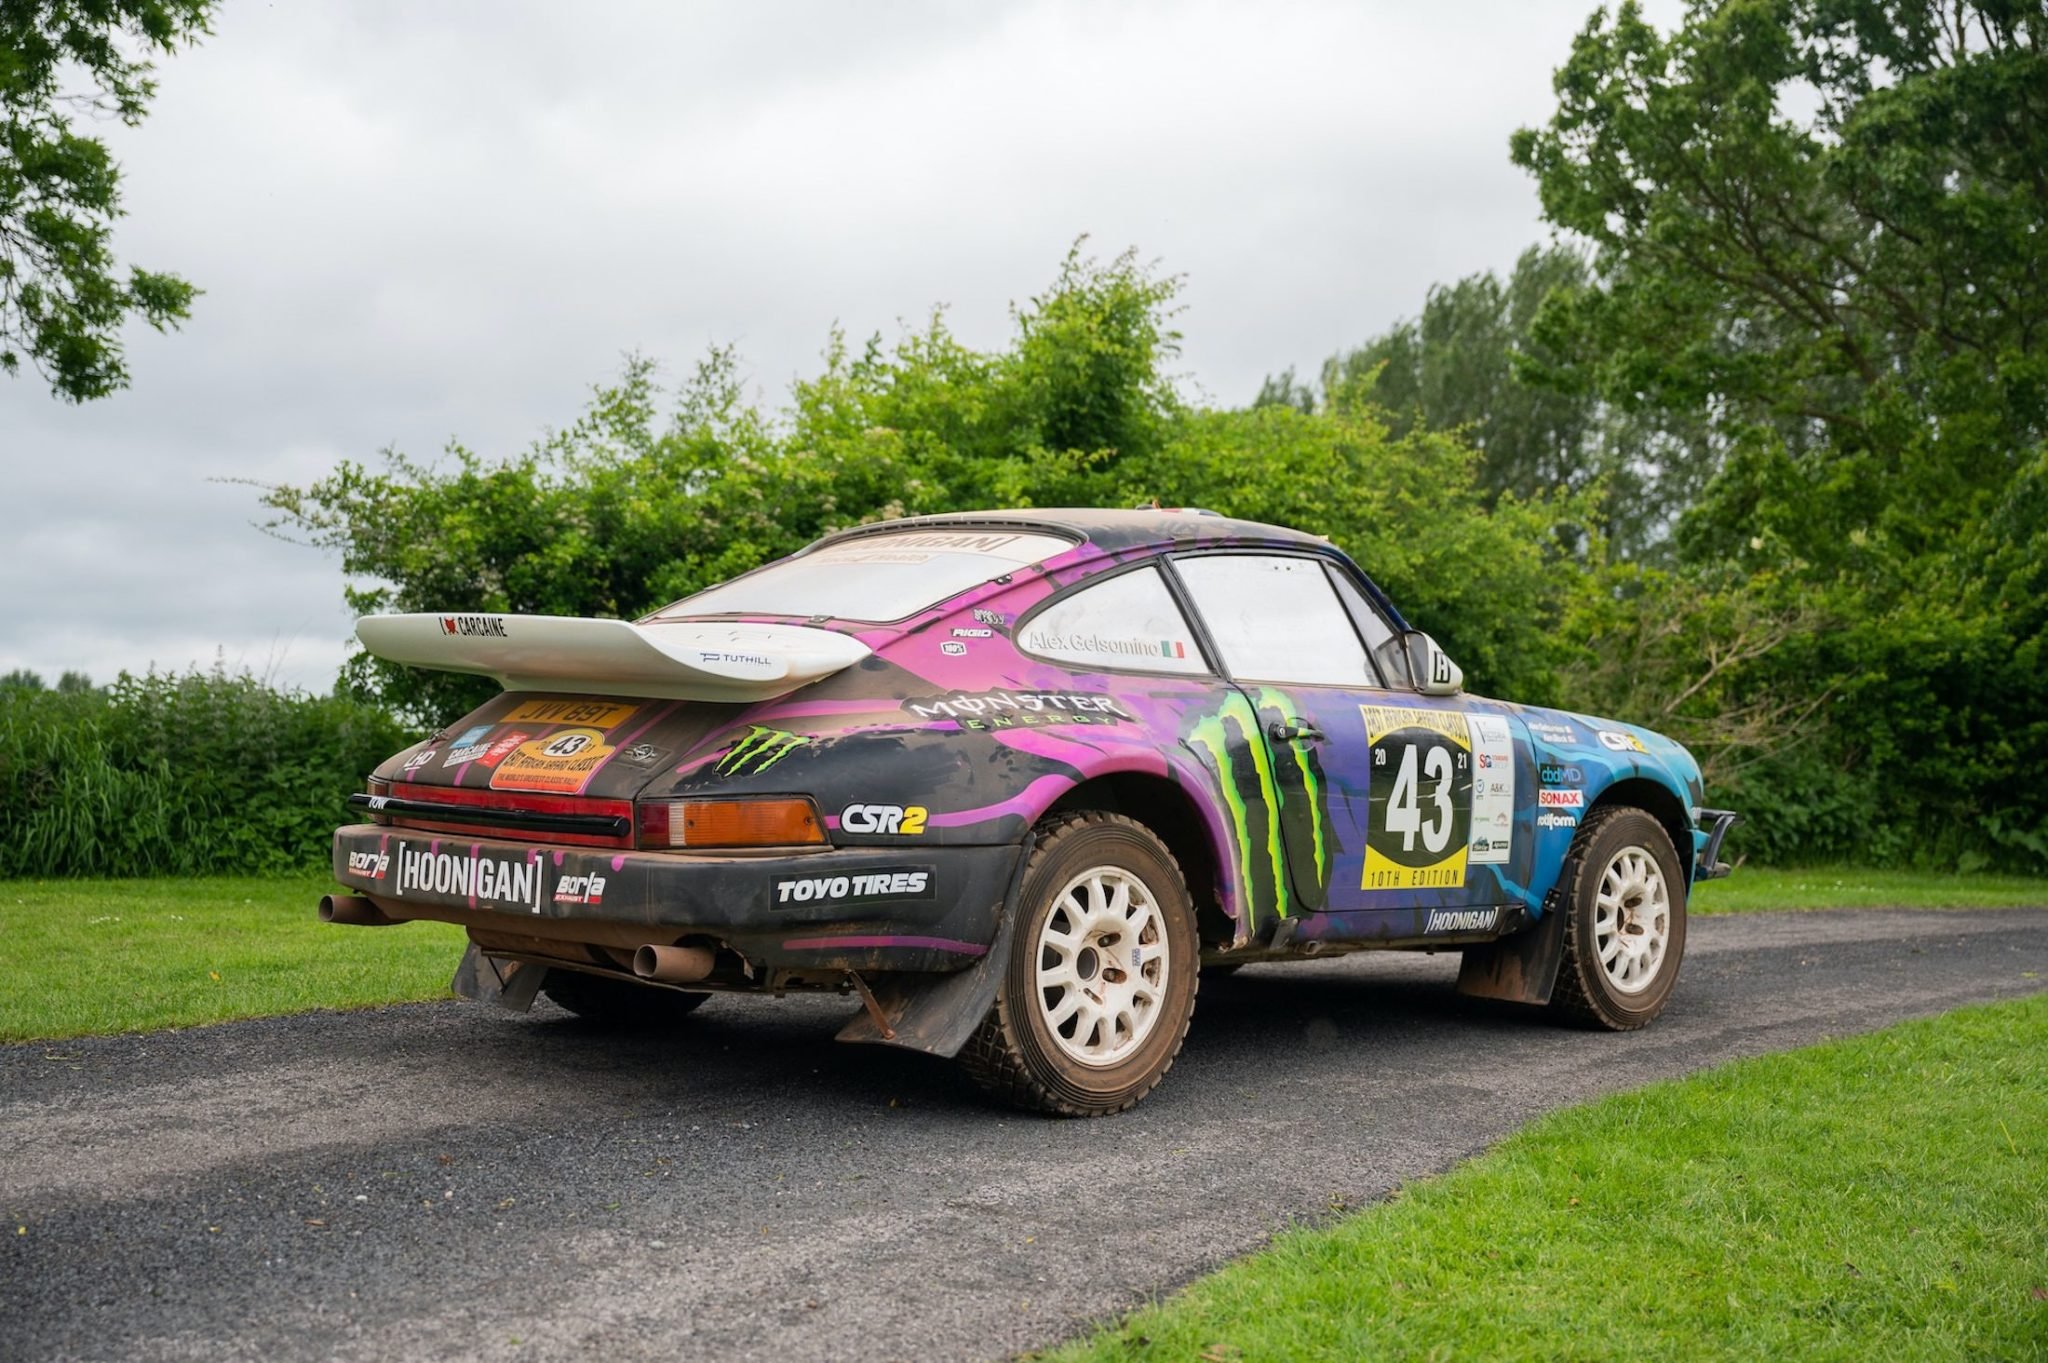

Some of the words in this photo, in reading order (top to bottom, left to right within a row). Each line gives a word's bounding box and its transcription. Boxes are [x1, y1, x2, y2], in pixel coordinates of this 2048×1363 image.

[458, 616, 508, 637] CARCAINE
[952, 628, 993, 638] RIGID
[1029, 631, 1068, 651] Alex
[1069, 632, 1159, 657] Gelsomino
[723, 654, 772, 665] TUTHILL
[967, 714, 1117, 730] ENERGY
[550, 736, 588, 755] 43
[404, 750, 437, 768] LHD
[1375, 748, 1387, 766] 20
[1457, 752, 1468, 769] 21
[1541, 766, 1581, 782] cbdMD
[368, 796, 389, 810] TOW
[1385, 744, 1454, 854] 43
[1540, 792, 1580, 805] SONAX
[841, 803, 929, 835] CSR2
[396, 841, 544, 915] [HOONIGAN]
[1371, 870, 1400, 887] 10TH
[1411, 869, 1459, 886] EDITION
[777, 876, 850, 903] TOYO
[851, 872, 929, 897] TIRES
[1424, 906, 1499, 934] [HOONIGAN]
